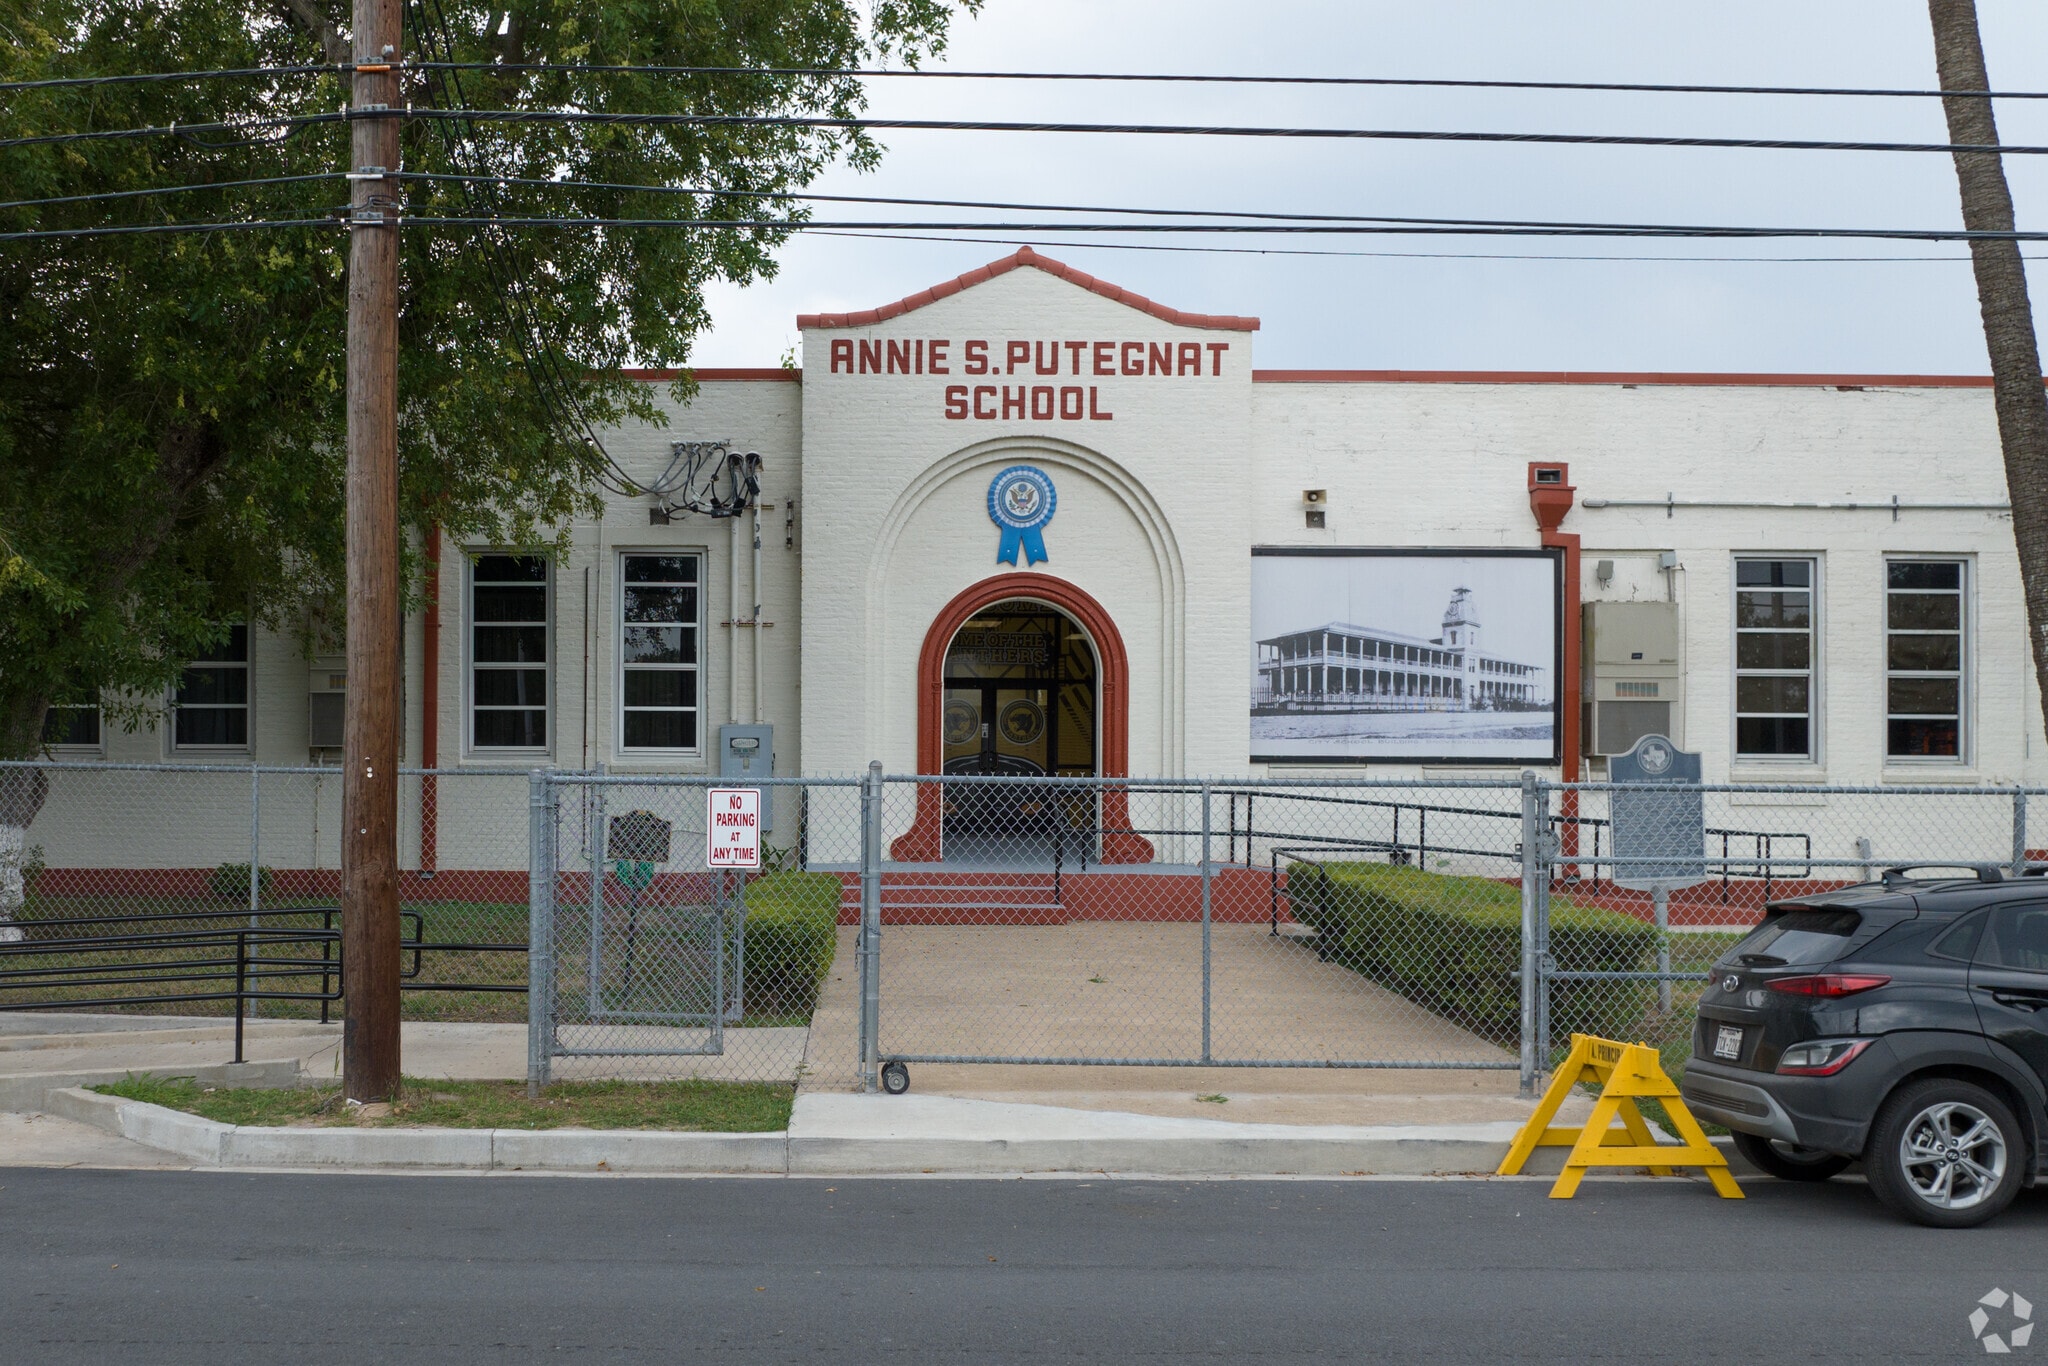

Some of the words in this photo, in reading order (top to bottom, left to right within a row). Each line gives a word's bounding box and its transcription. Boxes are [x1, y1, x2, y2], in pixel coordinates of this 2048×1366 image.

[830, 339, 950, 375] ANNIE
[945, 385, 1113, 421] SCHOOL
[986, 632, 1010, 648] OF
[1010, 633, 1045, 648] THE
[948, 647, 1045, 664] ANTHERS
[729, 796, 742, 810] NO
[716, 812, 755, 827] PARKING
[730, 832, 741, 842] AT
[713, 847, 732, 860] ANY
[733, 847, 755, 860] TIME
[1597, 1043, 1624, 1064] PRINCIP
